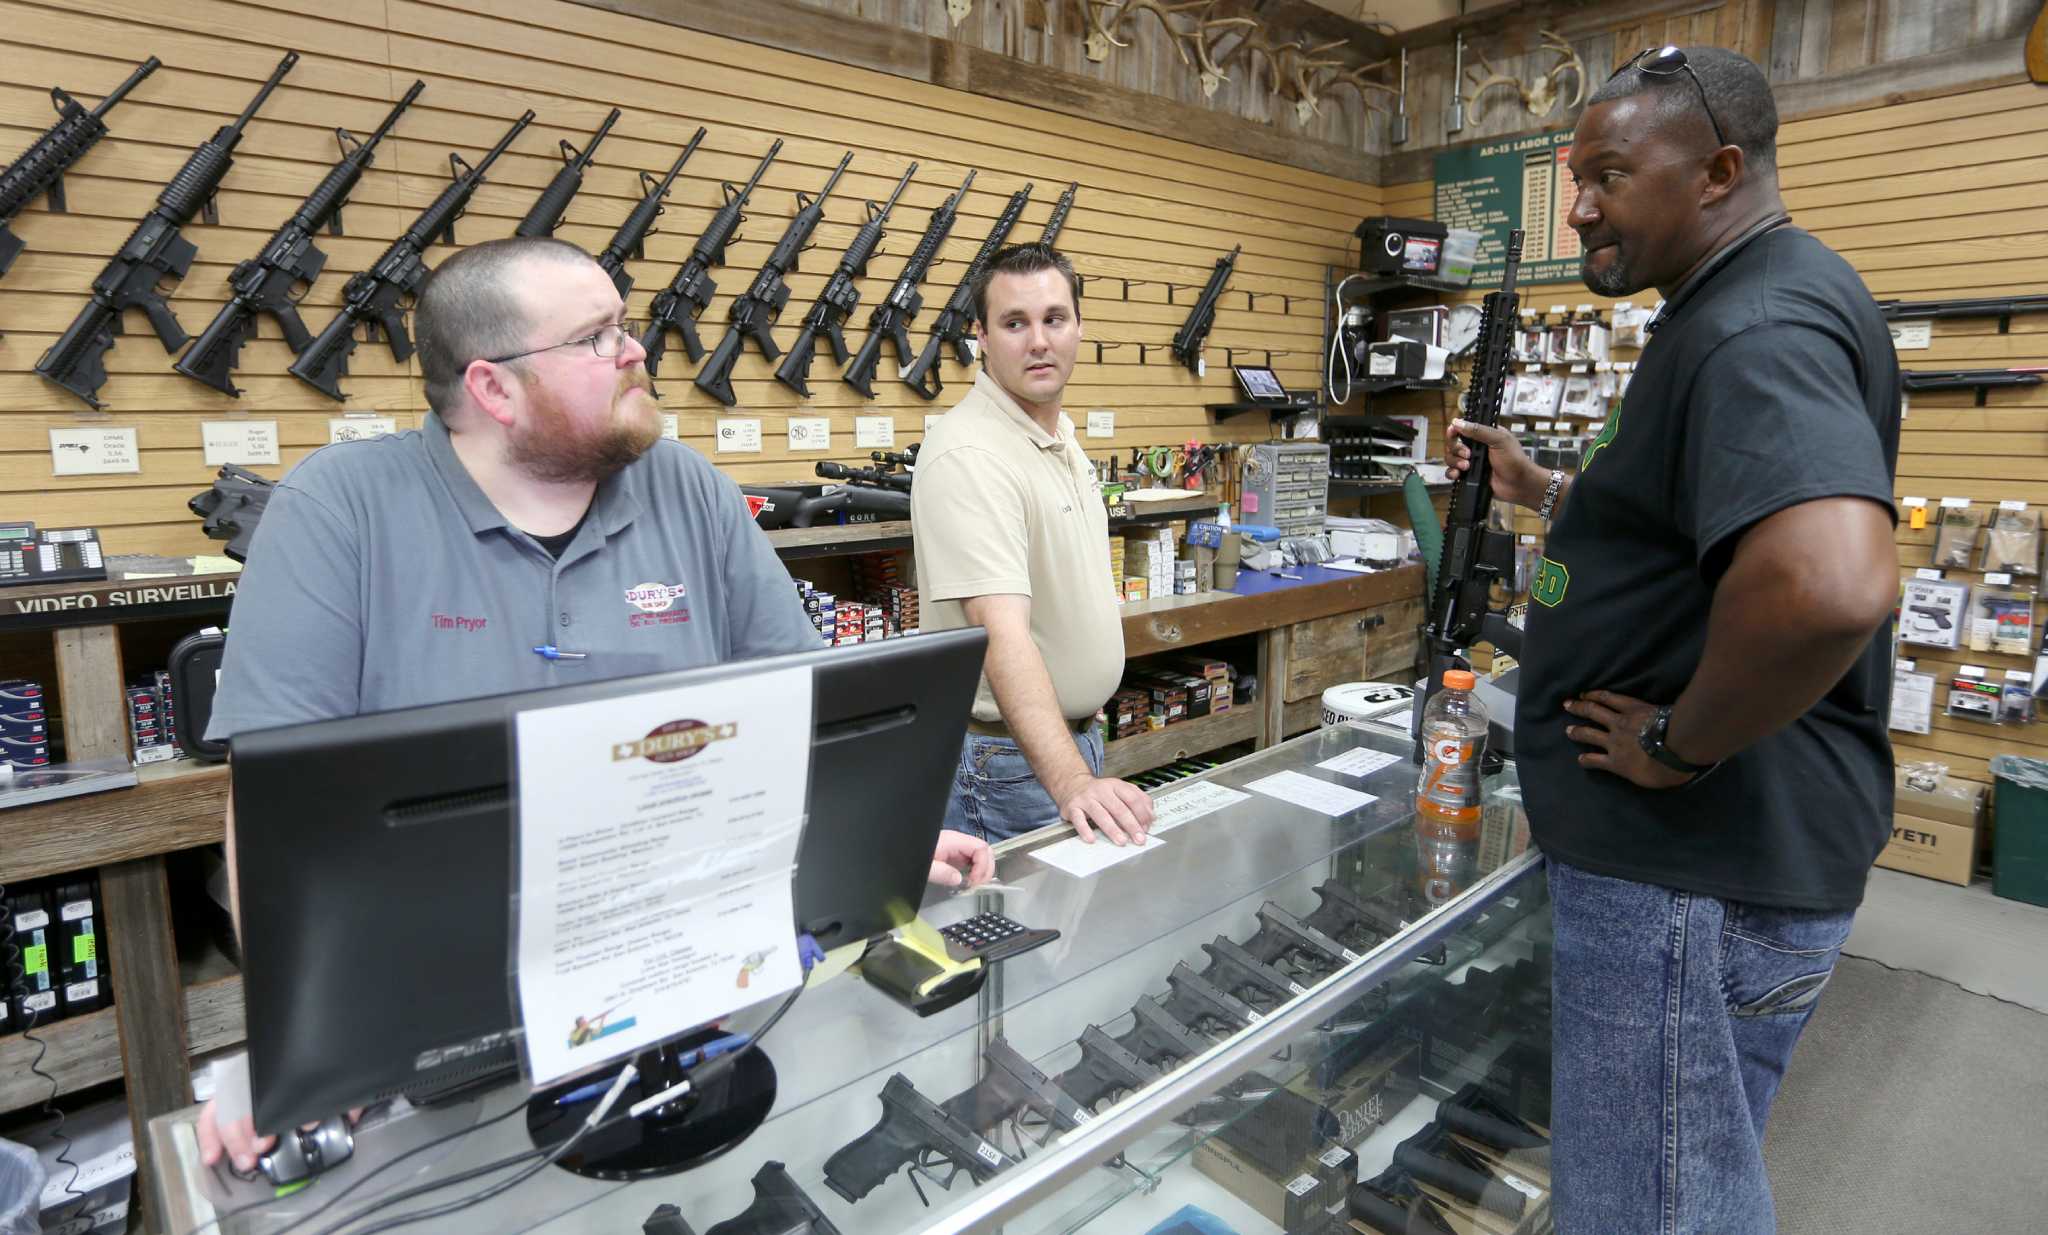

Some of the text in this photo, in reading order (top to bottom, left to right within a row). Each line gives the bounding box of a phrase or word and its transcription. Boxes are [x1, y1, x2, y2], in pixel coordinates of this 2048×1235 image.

[1480, 143, 1510, 157] AR-15
[1513, 137, 1550, 151] LABOR
[1109, 506, 1127, 517] USE
[628, 586, 677, 601] DURY'S
[16, 594, 98, 614] VIDEO
[432, 613, 487, 632] Tim Pryor
[640, 727, 717, 757] DURY'S
[1892, 827, 1938, 847] YETI
